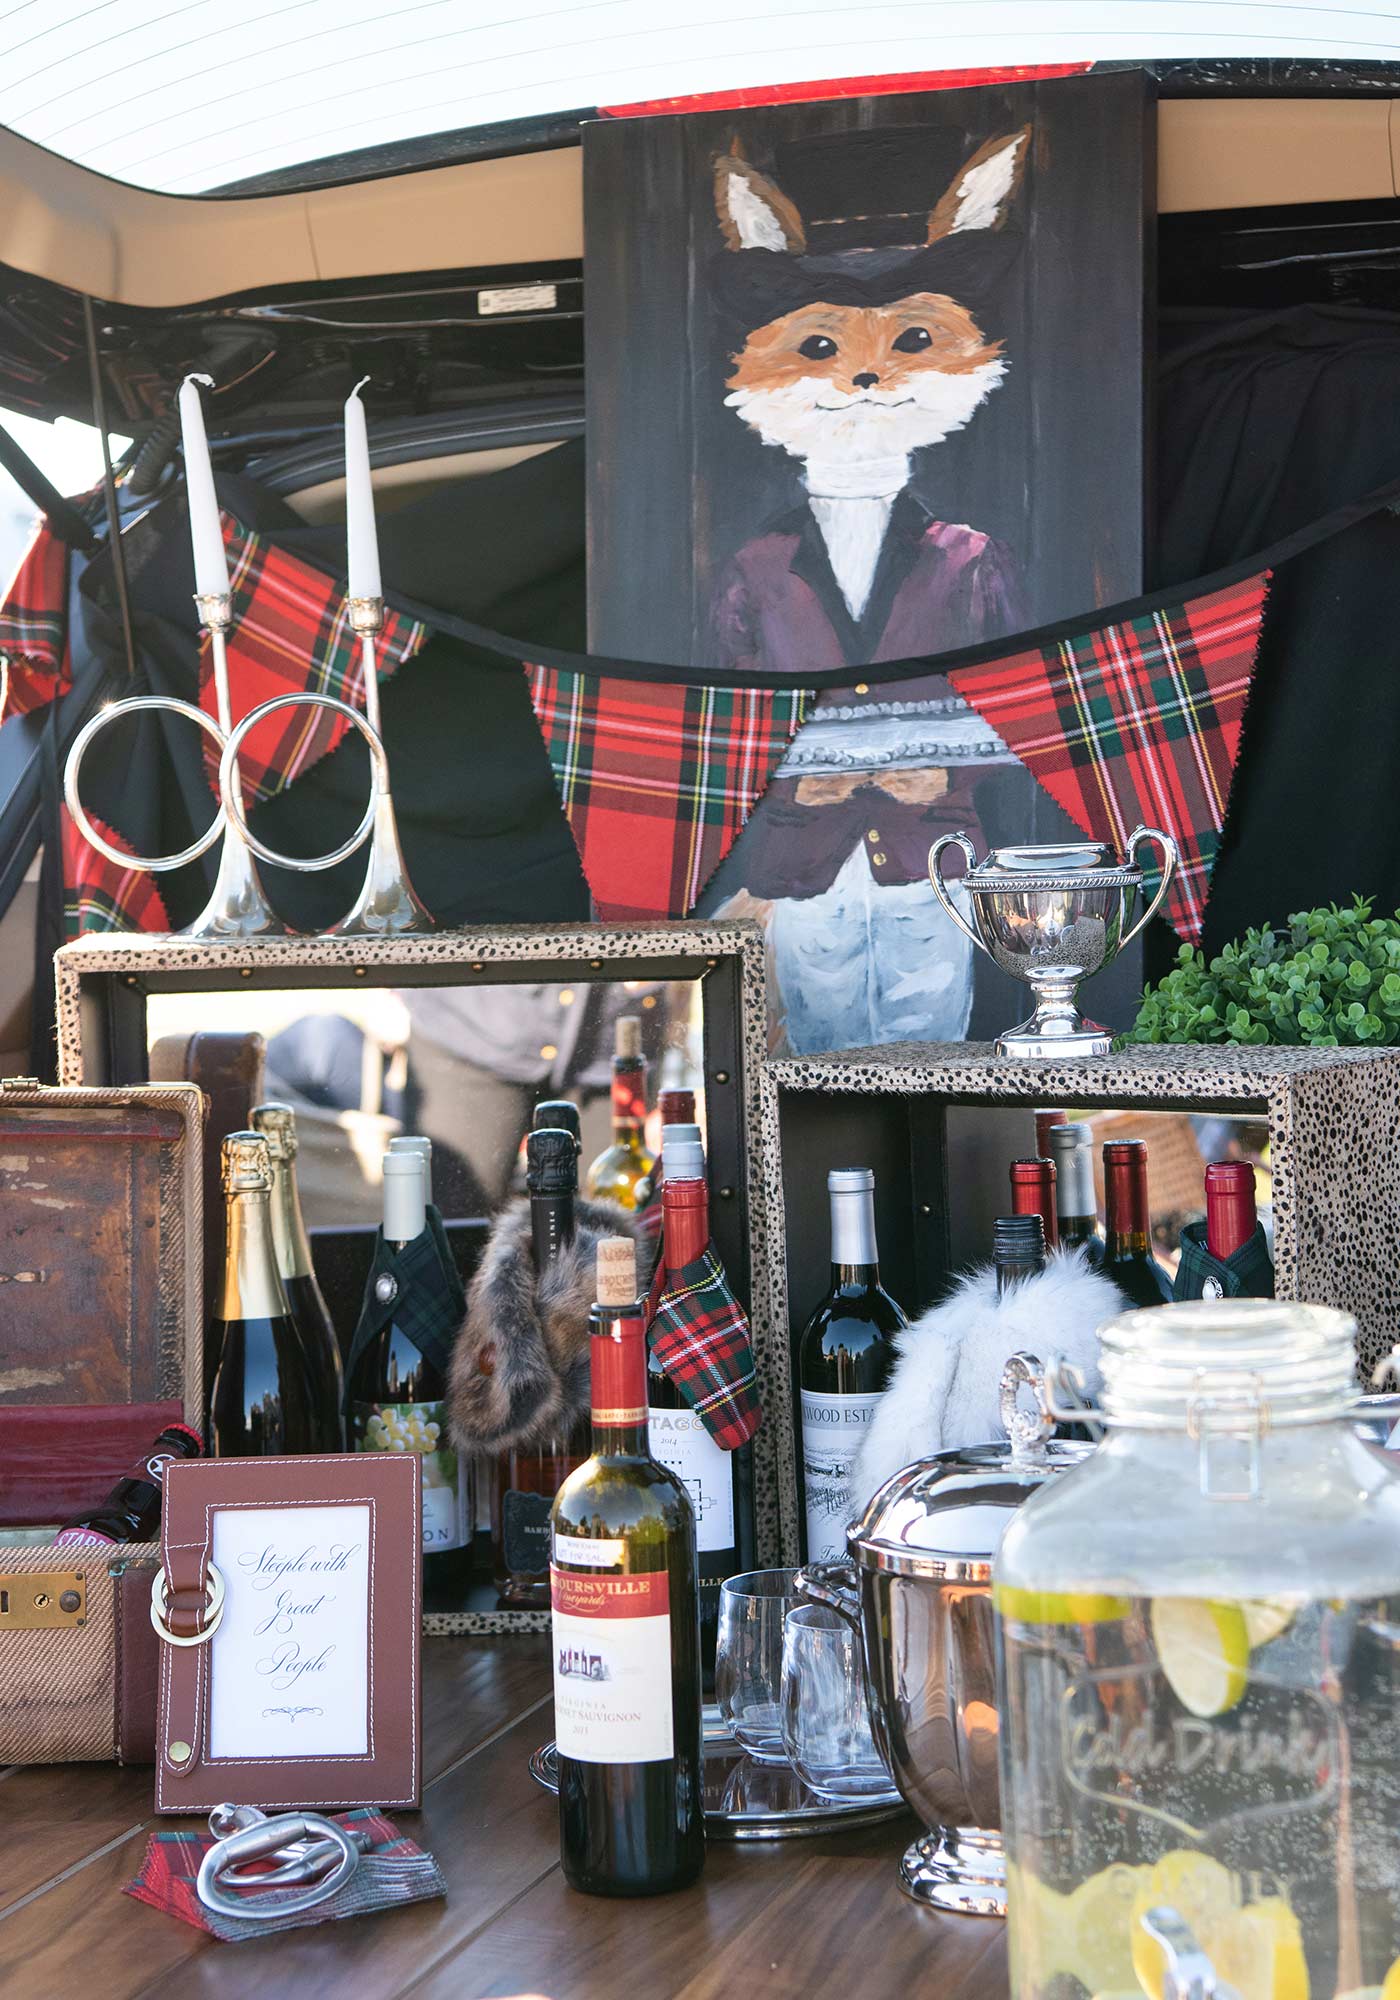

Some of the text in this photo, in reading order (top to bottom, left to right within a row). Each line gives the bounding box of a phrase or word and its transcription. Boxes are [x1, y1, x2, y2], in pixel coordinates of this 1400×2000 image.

[803, 1406, 840, 1423] WOOD
[660, 1437, 678, 1446] 2014
[237, 1543, 362, 1591] Steeple with
[253, 1588, 337, 1637] Great
[255, 1640, 337, 1691] People
